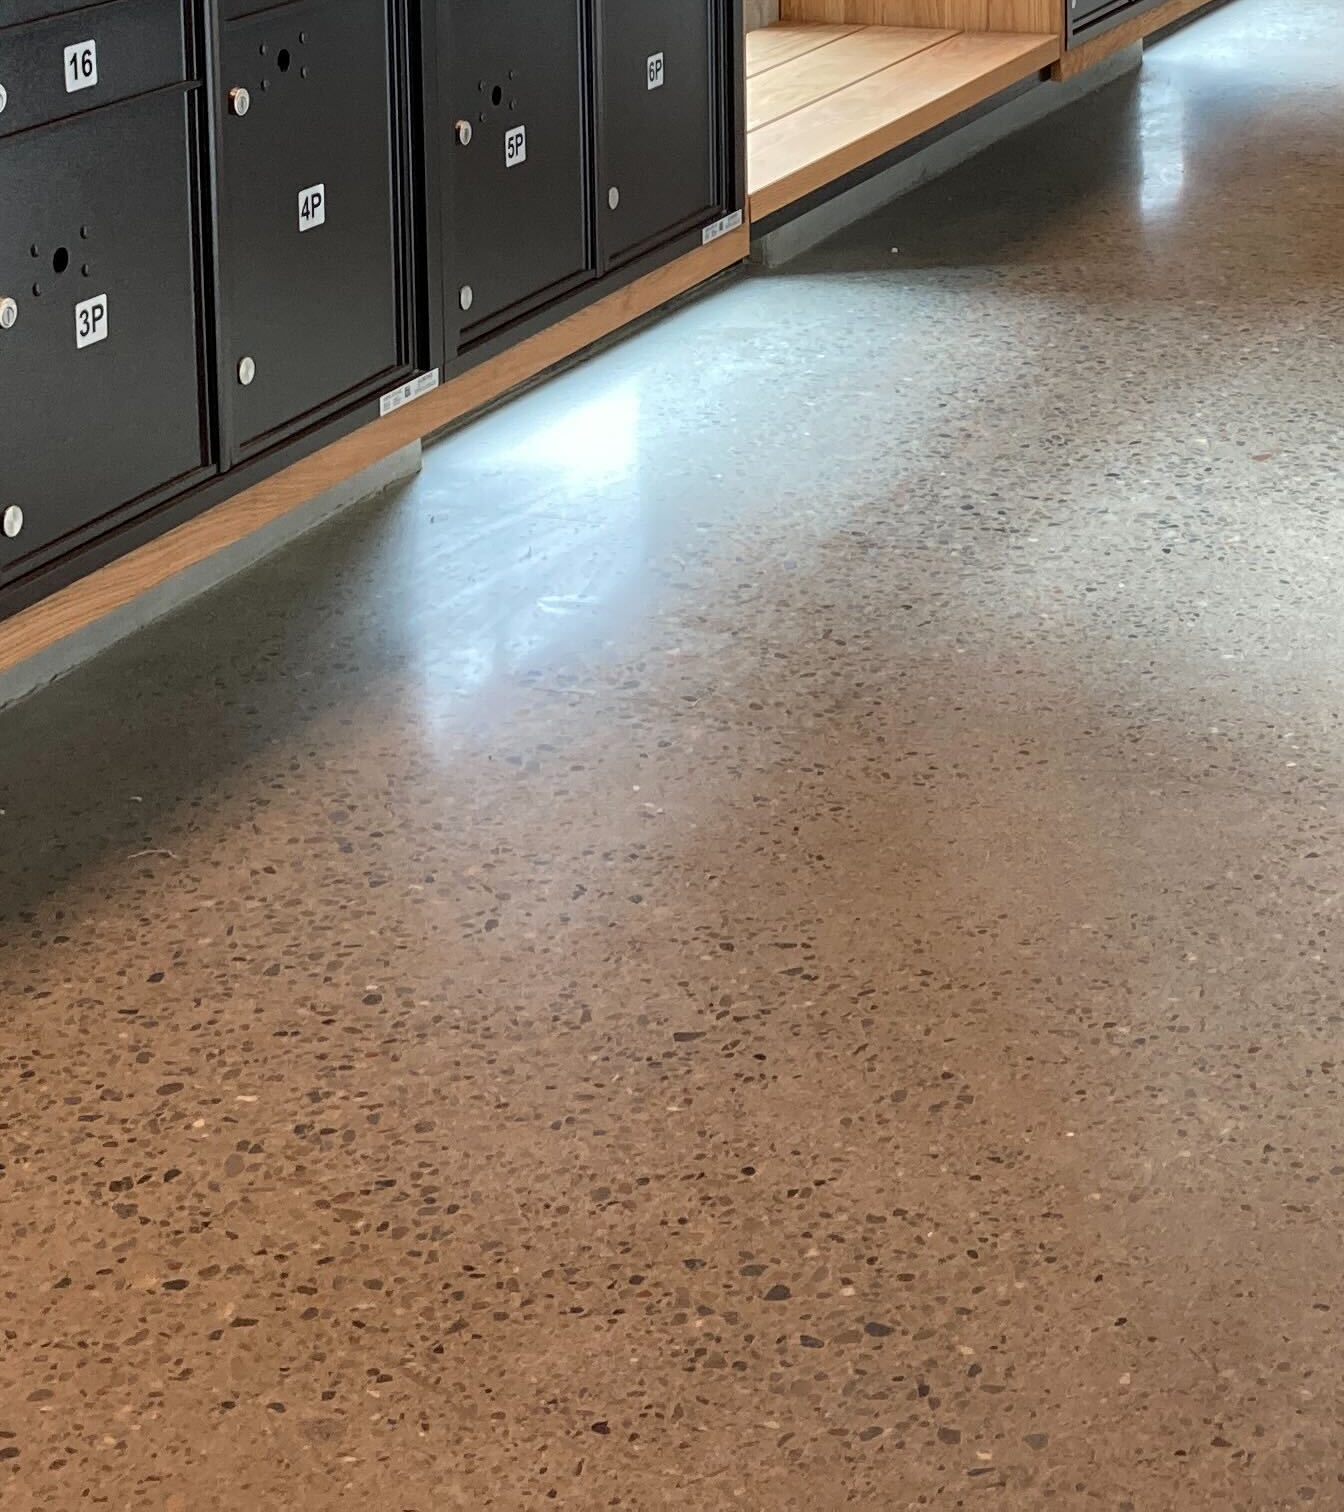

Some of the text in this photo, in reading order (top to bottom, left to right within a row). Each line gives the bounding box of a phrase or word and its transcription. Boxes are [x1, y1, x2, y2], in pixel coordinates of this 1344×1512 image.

[69, 49, 93, 81] 16
[649, 59, 662, 82] 6P
[507, 132, 524, 159] 5P
[300, 192, 322, 221] 4P
[79, 303, 104, 337] 3P
